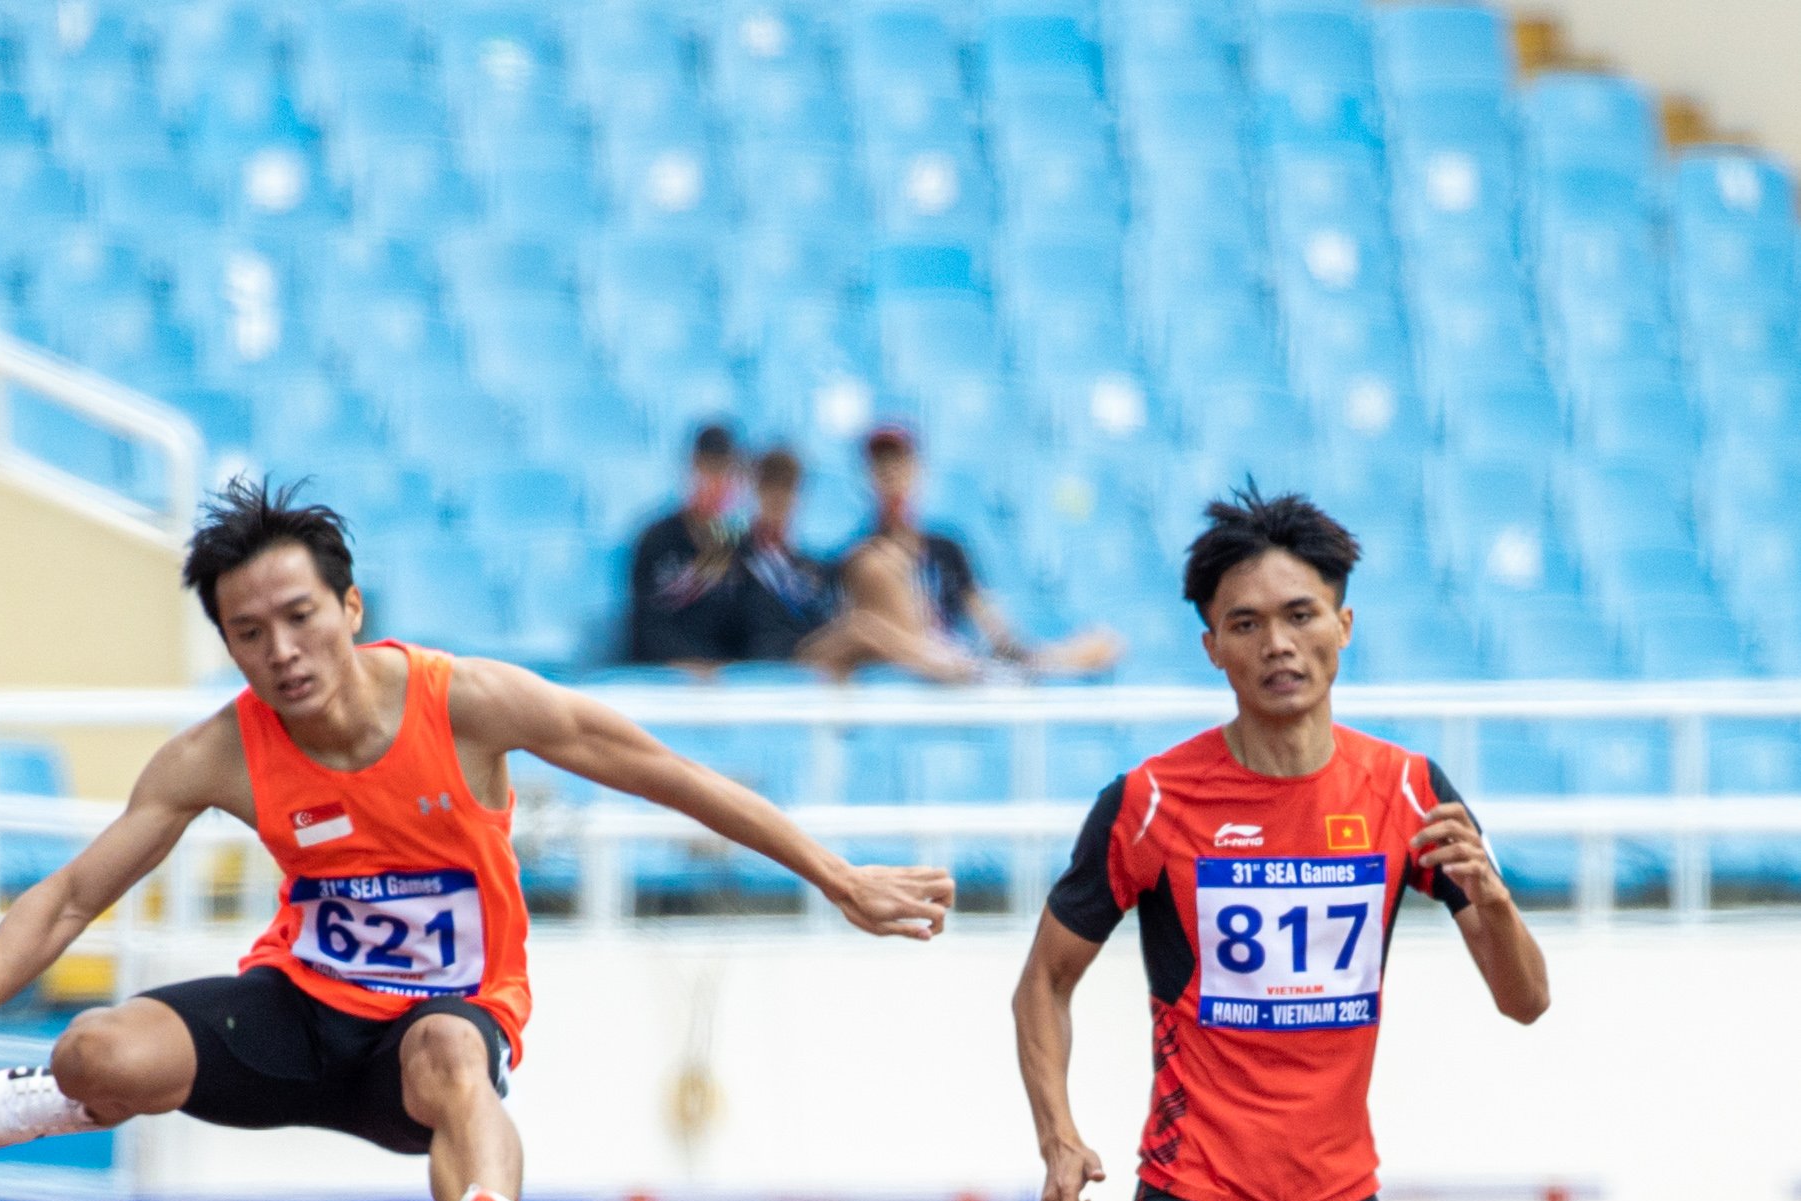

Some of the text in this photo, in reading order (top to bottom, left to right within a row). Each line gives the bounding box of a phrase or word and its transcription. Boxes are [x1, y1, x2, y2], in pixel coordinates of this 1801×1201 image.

[1264, 862, 1297, 884] SEA
[1300, 862, 1356, 884] Games
[349, 877, 381, 899] SEA
[386, 875, 443, 895] Games
[316, 900, 456, 970] 621
[1215, 902, 1370, 974] 817
[1266, 984, 1325, 996] VIETNAM
[1212, 1001, 1259, 1025] HANOI
[1272, 1002, 1336, 1025] VIETNAM
[1338, 999, 1370, 1022] 2022
